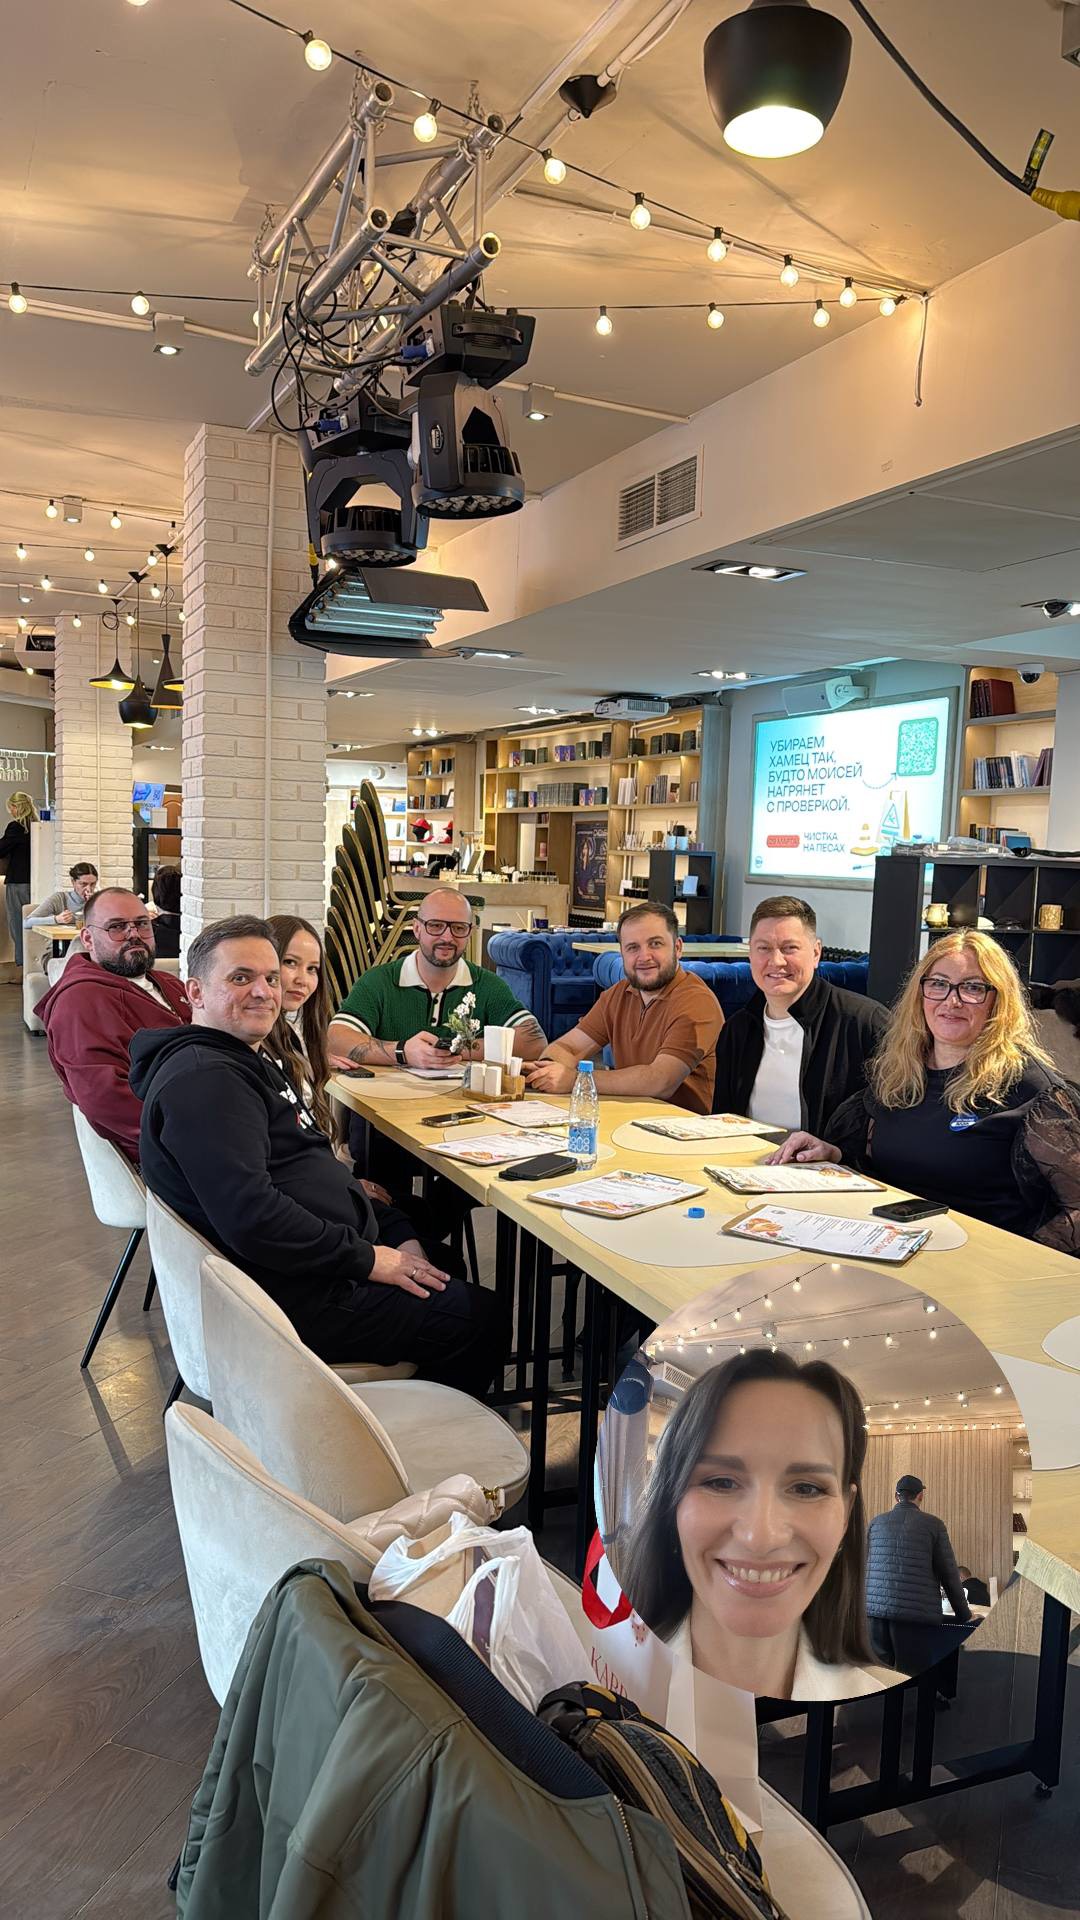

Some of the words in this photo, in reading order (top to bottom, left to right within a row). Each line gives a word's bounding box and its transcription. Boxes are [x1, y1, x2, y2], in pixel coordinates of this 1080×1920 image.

[770, 735, 825, 752] УБИРАЕМ
[769, 753, 809, 768] ХАМЕЦ
[811, 751, 837, 764] ТАК,
[768, 769, 806, 784] БУДТО
[807, 762, 863, 781] МОИСЕЙ
[767, 783, 826, 798] НАГРЯНЕТ
[766, 801, 775, 813] С
[776, 796, 851, 813] ПРОВЕРКОЙ.
[803, 831, 839, 841] ЧИСТКА
[802, 843, 815, 852] НА
[816, 843, 846, 853] ПЕСАХ
